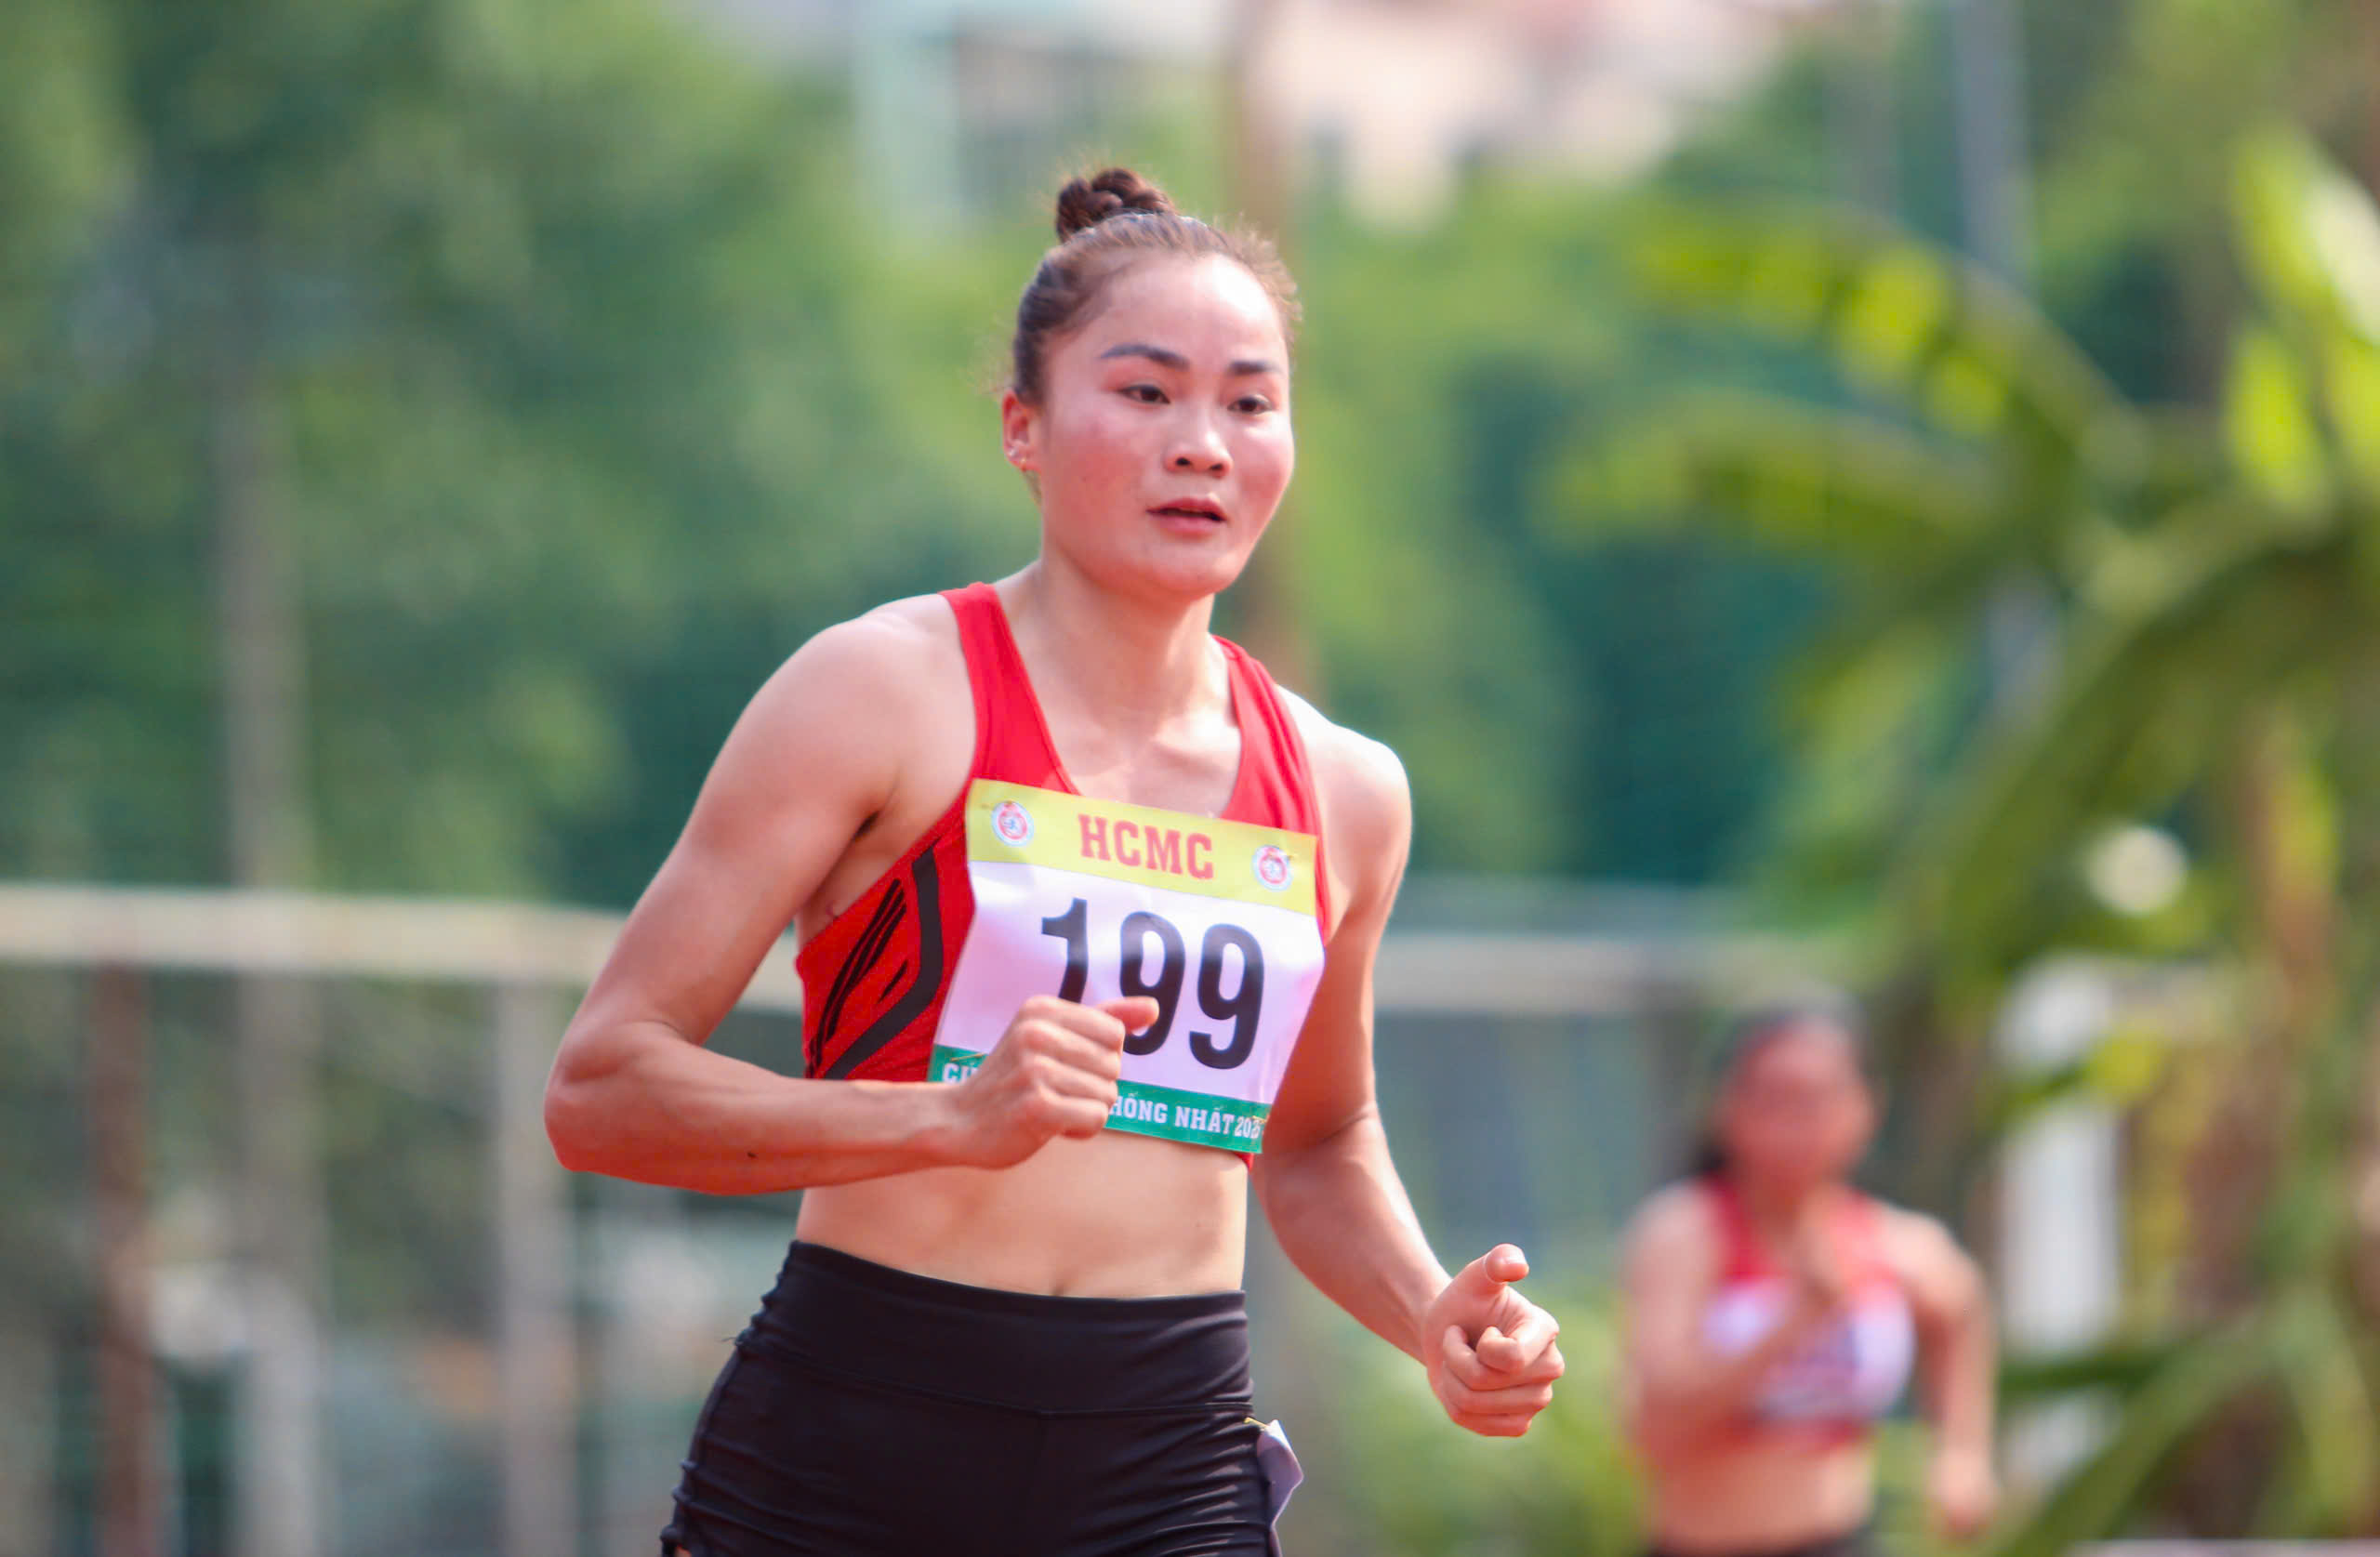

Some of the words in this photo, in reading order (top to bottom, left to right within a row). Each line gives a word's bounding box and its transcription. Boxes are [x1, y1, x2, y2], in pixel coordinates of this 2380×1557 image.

[1078, 813, 1214, 879] HCMC
[1041, 897, 1264, 1070] 199
[1108, 1091, 1169, 1124] HỐNG
